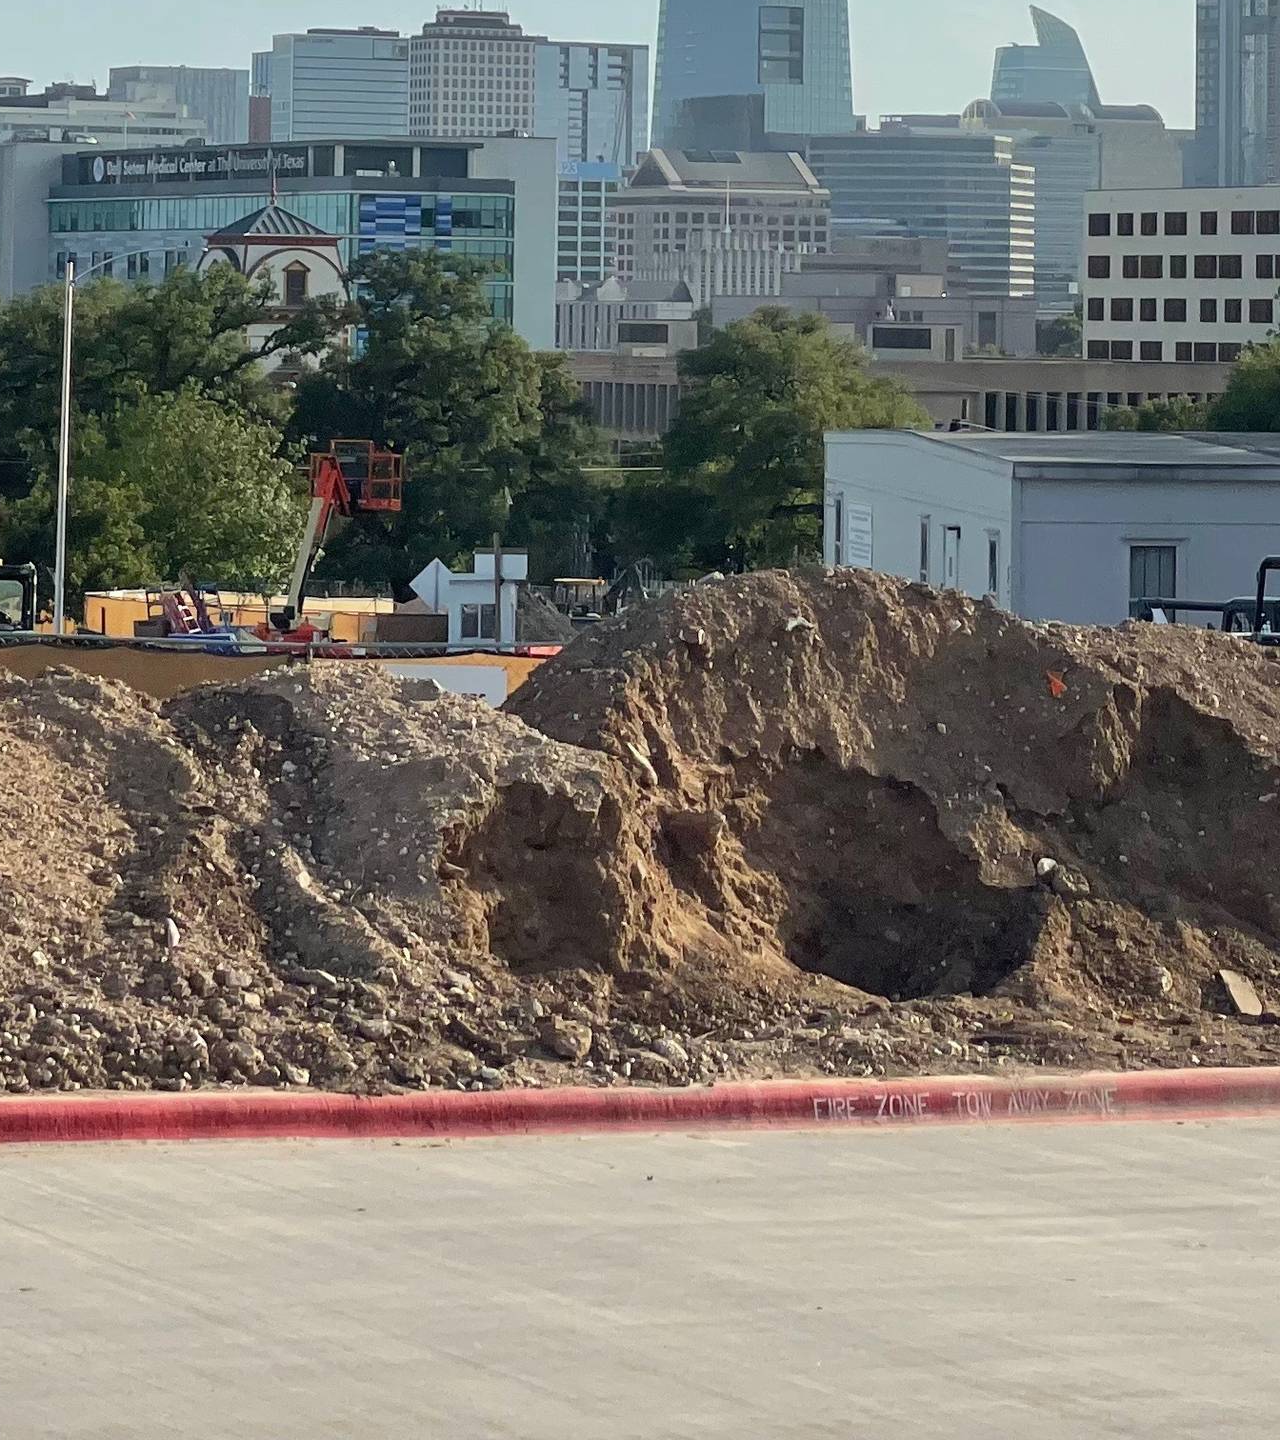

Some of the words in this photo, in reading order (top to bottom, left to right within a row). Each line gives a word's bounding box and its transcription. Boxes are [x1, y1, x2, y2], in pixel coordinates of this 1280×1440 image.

[147, 157, 178, 174] Medical
[180, 158, 206, 173] Center
[208, 159, 216, 172] at
[234, 152, 272, 174] University
[283, 154, 305, 169] Texas
[813, 1096, 859, 1122] FIRE
[874, 1091, 931, 1121] ZONE
[952, 1091, 992, 1120] TOW
[1008, 1089, 1052, 1115] AWAY
[1064, 1088, 1118, 1118] ZONE
